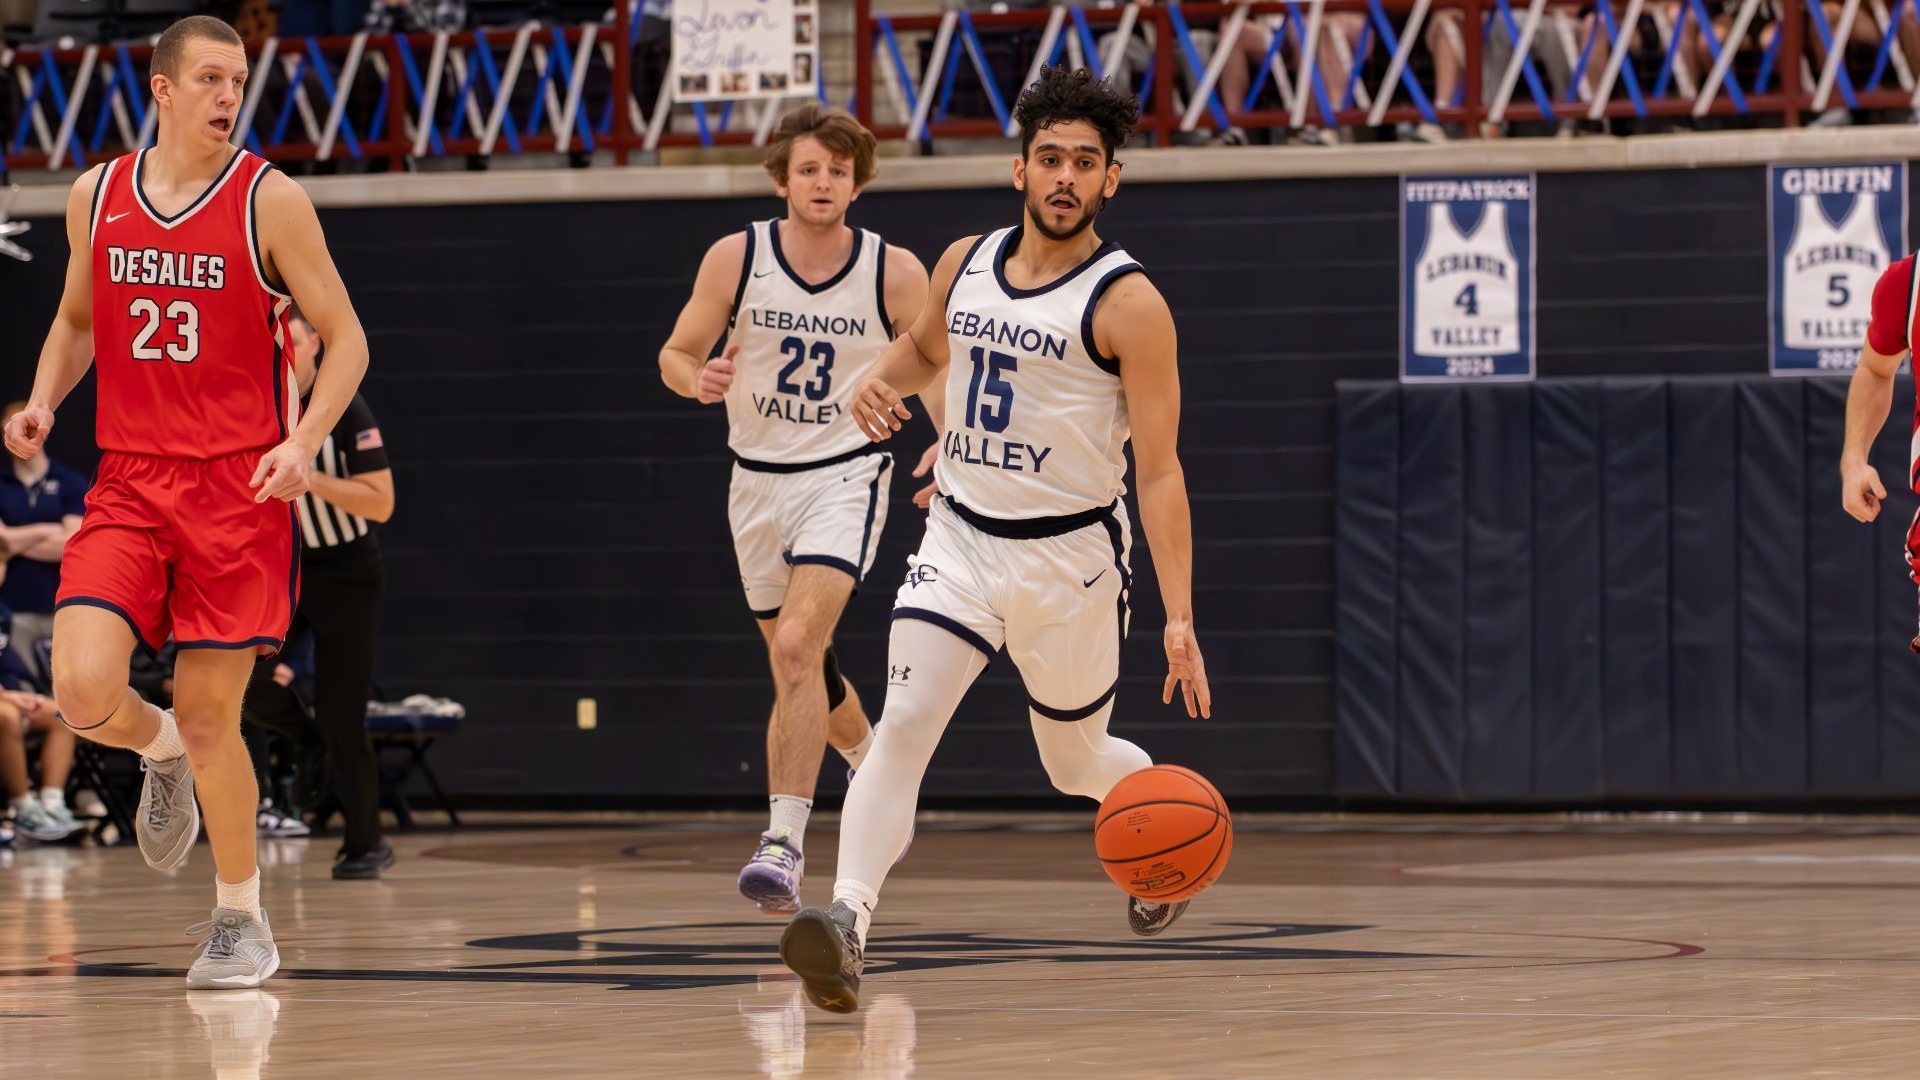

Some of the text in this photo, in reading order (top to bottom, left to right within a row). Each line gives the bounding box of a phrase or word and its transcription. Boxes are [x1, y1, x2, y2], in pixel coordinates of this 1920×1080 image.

[1407, 180, 1530, 202] FITZPATRICK
[1782, 166, 1893, 195] GRIFFIN
[1427, 252, 1508, 282] LEBANON
[1795, 243, 1879, 274] LEBANON
[1454, 282, 1479, 316] 4
[1827, 274, 1850, 308] 5
[129, 296, 199, 363] 23
[752, 309, 866, 336] LEBANON
[1431, 327, 1502, 347] VALLEY
[777, 336, 835, 401] 23
[965, 345, 1018, 433] 15
